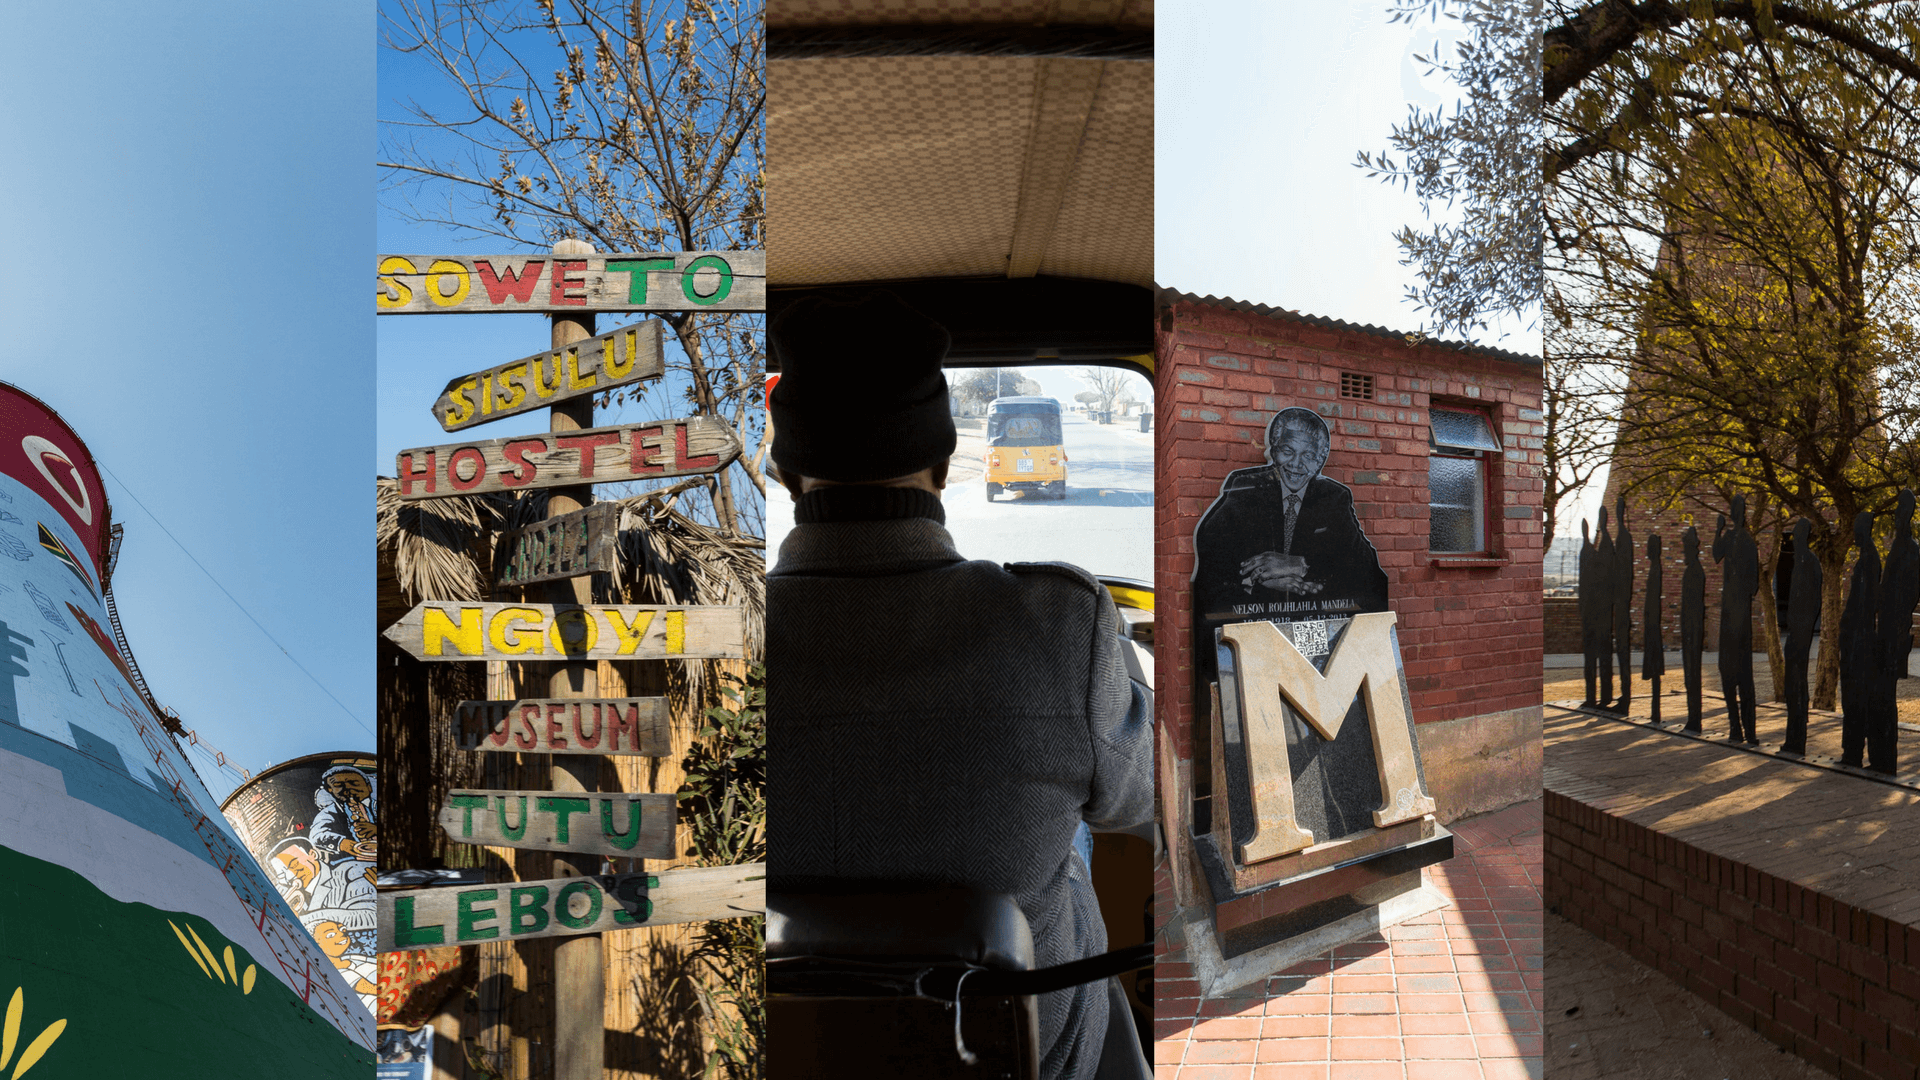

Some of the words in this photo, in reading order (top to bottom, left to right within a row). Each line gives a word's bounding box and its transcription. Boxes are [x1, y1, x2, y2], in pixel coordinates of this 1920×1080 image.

[377, 255, 734, 308] SOWETO
[445, 329, 637, 427] SISULU
[401, 423, 720, 495] HOSTEL
[422, 606, 686, 656] NGOYI
[1233, 603, 1265, 614] NELSON
[1268, 601, 1317, 612] ROLIHLAHLA
[1321, 599, 1355, 610] MANDELA
[459, 702, 642, 752] MUSEUM
[1220, 611, 1436, 865] M
[450, 795, 643, 851] TUTU
